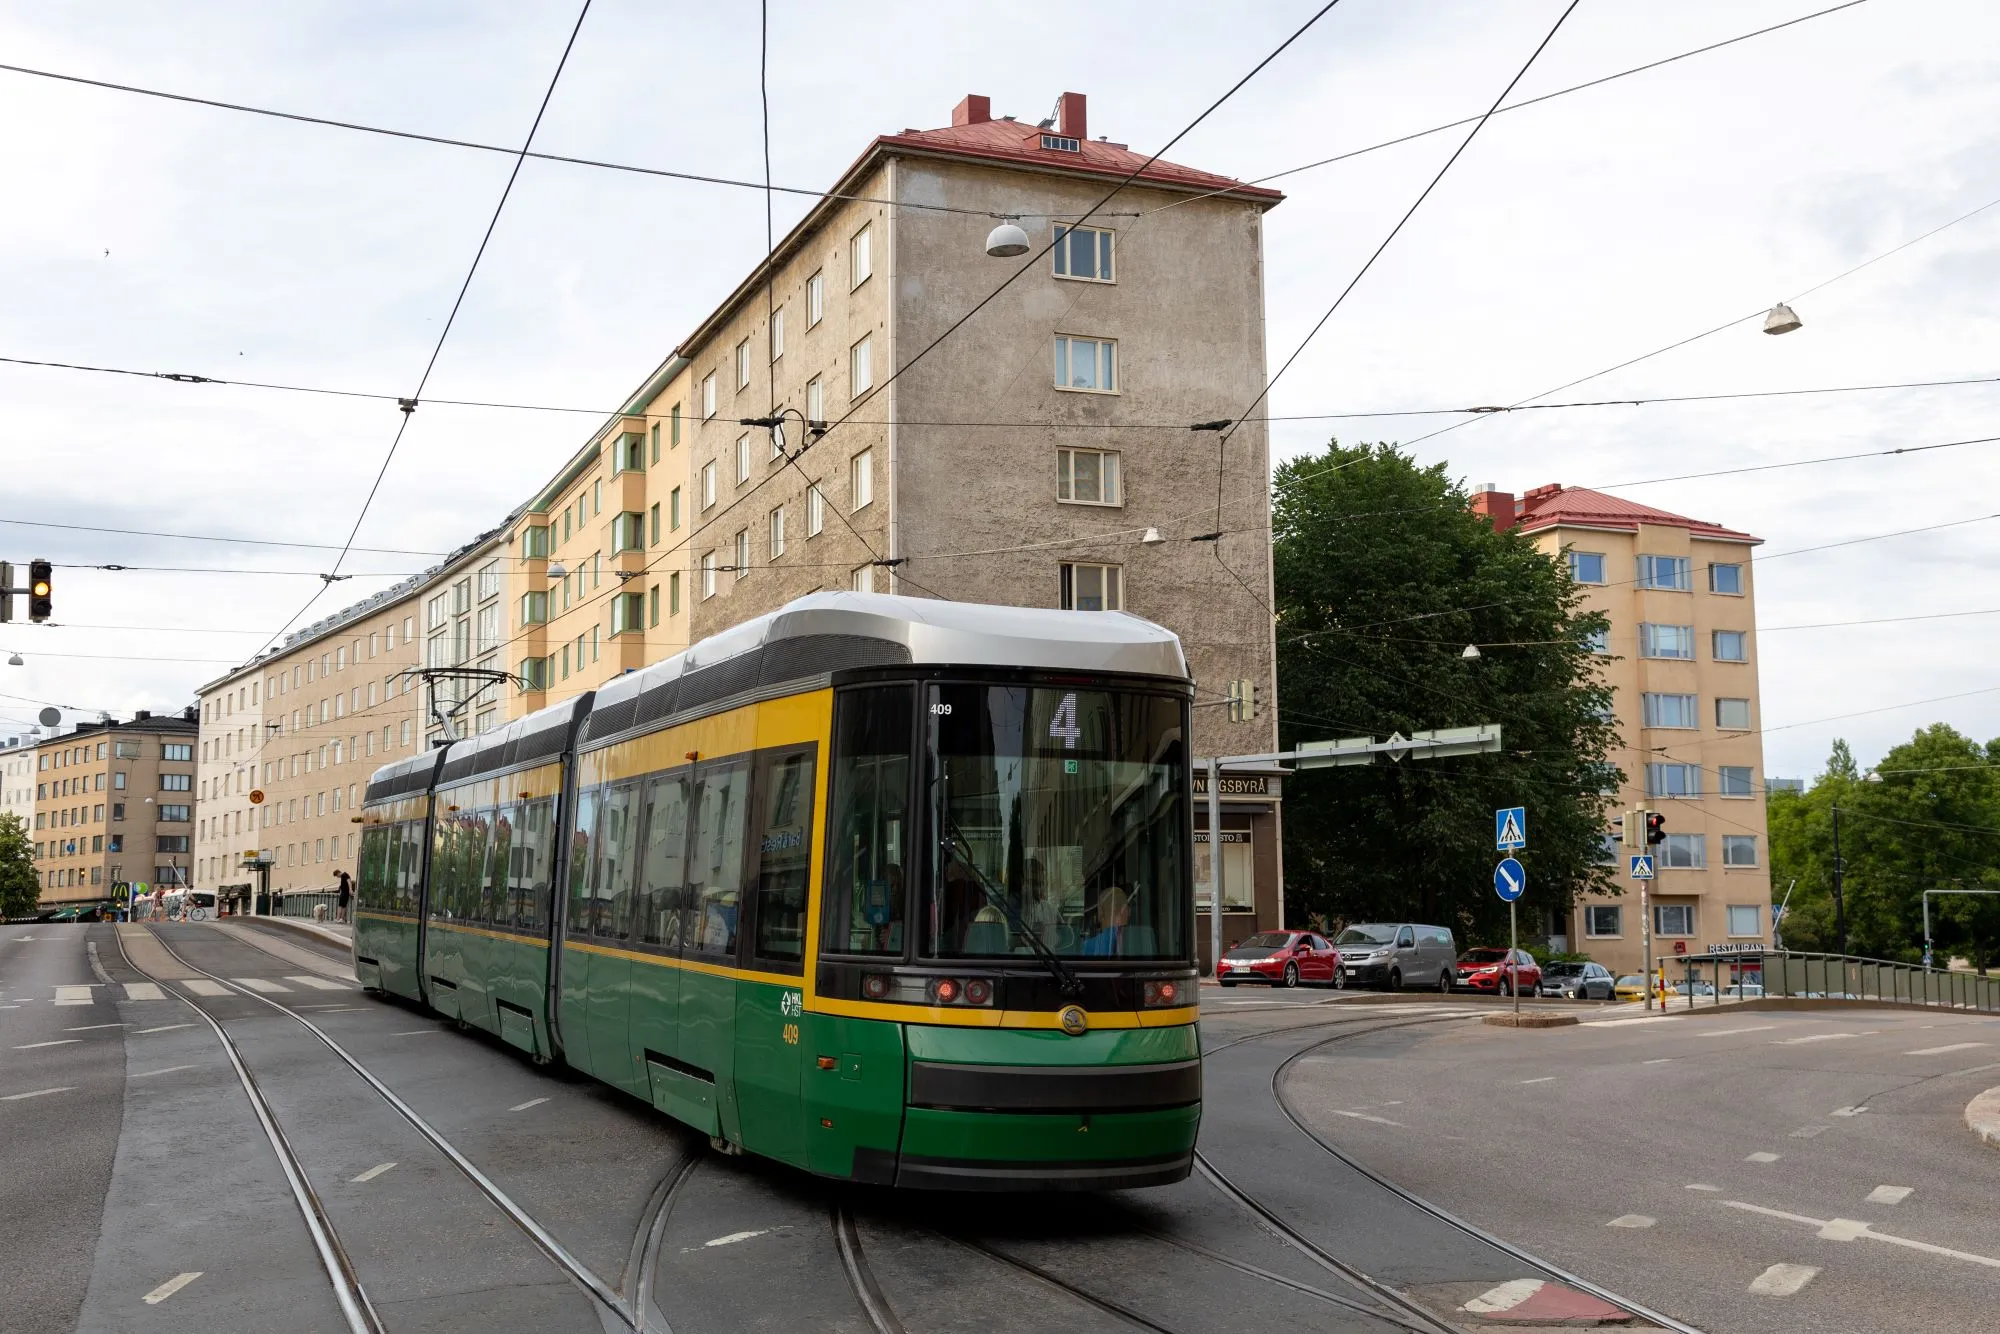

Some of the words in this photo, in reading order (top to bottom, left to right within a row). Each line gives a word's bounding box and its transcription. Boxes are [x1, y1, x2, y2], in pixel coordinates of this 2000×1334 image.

[930, 704, 952, 715] 409
[1050, 694, 1081, 749] 4
[1709, 943, 1767, 954] RESTAURANT
[792, 992, 802, 1005] HKL
[792, 1004, 802, 1018] HST
[783, 1023, 799, 1045] 409
